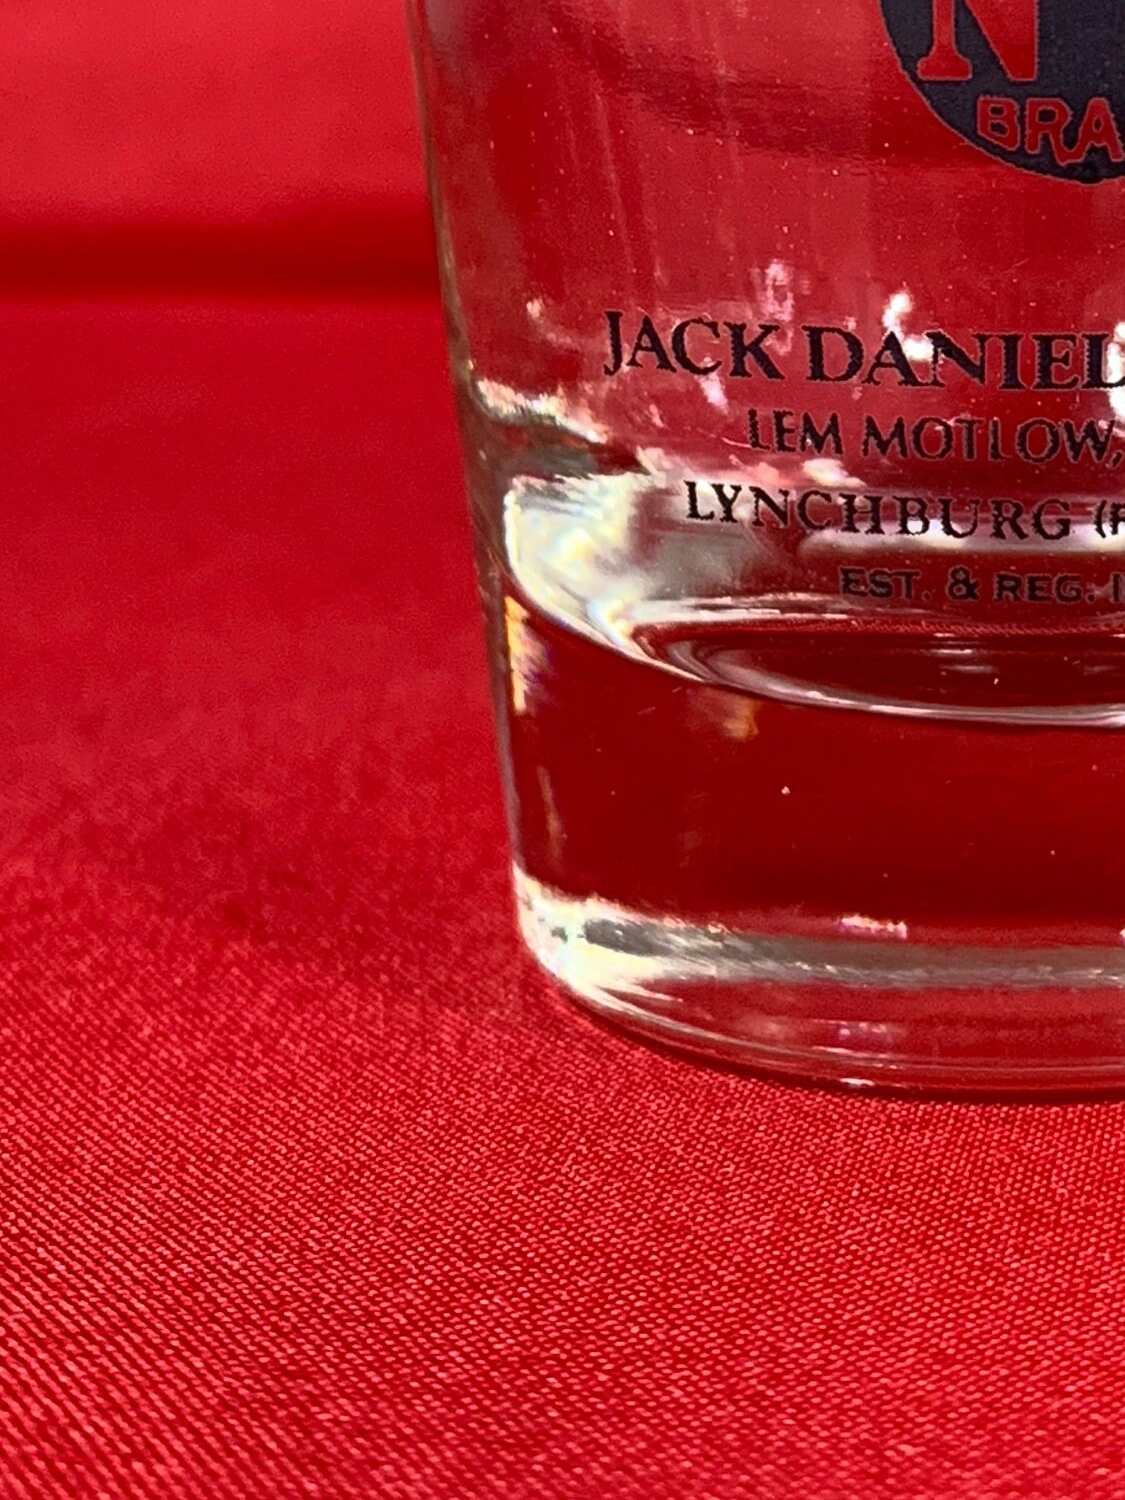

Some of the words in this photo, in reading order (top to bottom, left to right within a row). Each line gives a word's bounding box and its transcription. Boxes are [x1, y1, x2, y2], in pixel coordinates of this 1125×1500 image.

[603, 310, 786, 381] JACK
[746, 407, 845, 457] LEM
[683, 479, 1072, 541] LYNCHBURG
[839, 566, 933, 601] EST.
[947, 565, 980, 602] &
[992, 572, 1097, 605] REG.
